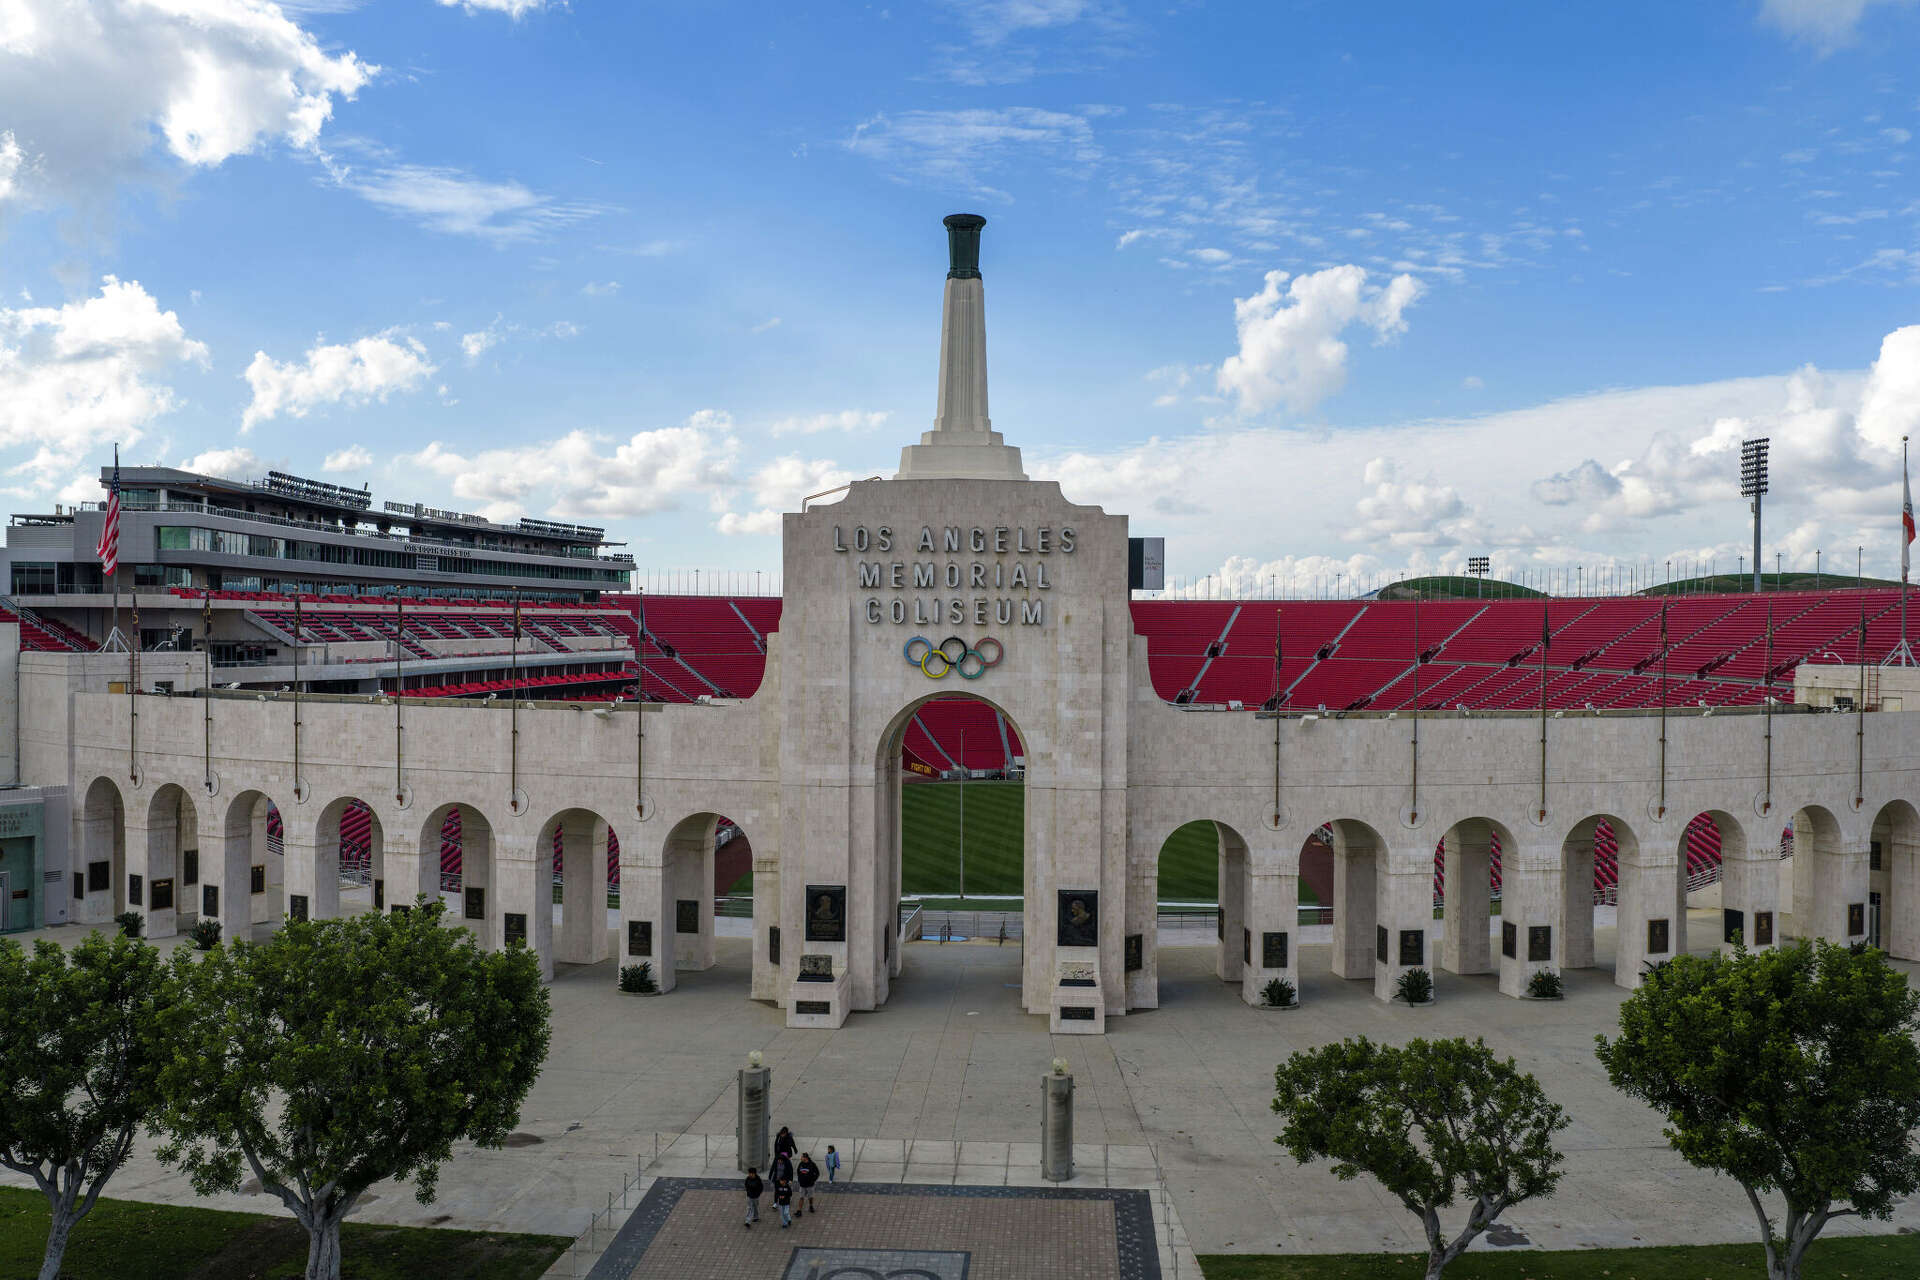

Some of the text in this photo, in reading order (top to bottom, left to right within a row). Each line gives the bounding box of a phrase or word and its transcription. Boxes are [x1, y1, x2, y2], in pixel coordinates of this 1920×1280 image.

[384, 501, 416, 515] UNITED
[833, 526, 1076, 553] LOS ANGELES
[859, 561, 1051, 589] MEMORIAL
[865, 598, 1043, 625] COLISEUM
